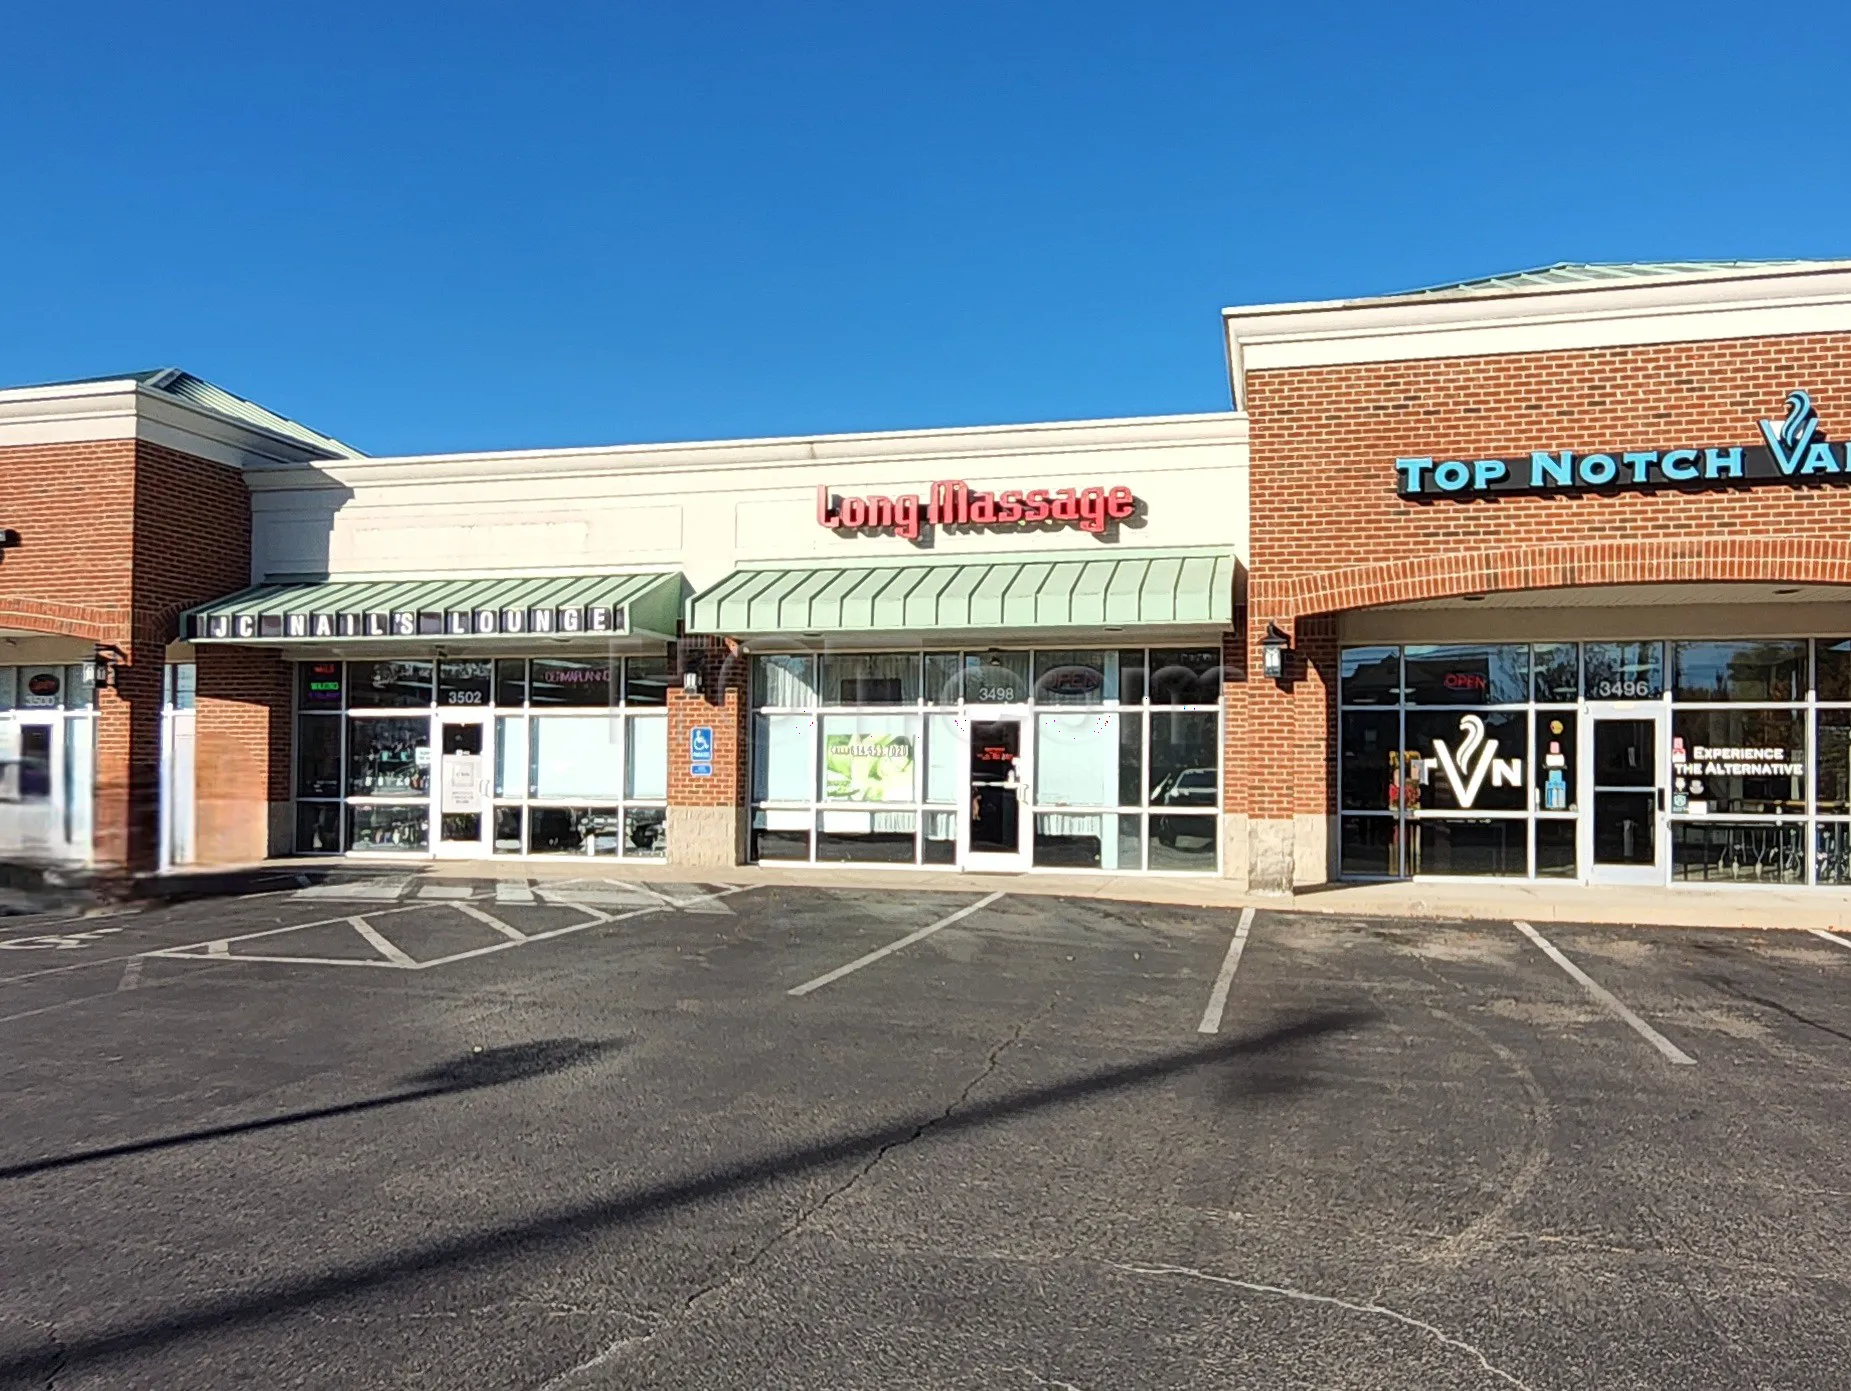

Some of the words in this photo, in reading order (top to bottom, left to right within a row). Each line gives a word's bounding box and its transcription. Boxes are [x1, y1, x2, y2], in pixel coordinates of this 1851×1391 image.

[1396, 456, 1506, 493] TOP
[1530, 447, 1744, 486] NOTCH
[1759, 412, 1851, 475] VA
[817, 484, 919, 539] Long
[928, 480, 1135, 533] Massage
[215, 615, 253, 637] JC
[290, 611, 413, 636] NAIL'S
[452, 608, 606, 634] LOUNGE
[1444, 674, 1487, 689] OPEN
[1599, 681, 1649, 697] 3496
[448, 691, 482, 703] 3502
[979, 687, 1014, 700] 3498
[1693, 746, 1785, 760] EXPERIENCE
[1674, 763, 1703, 775] THE
[1705, 761, 1804, 776] ALTERNATIVE
